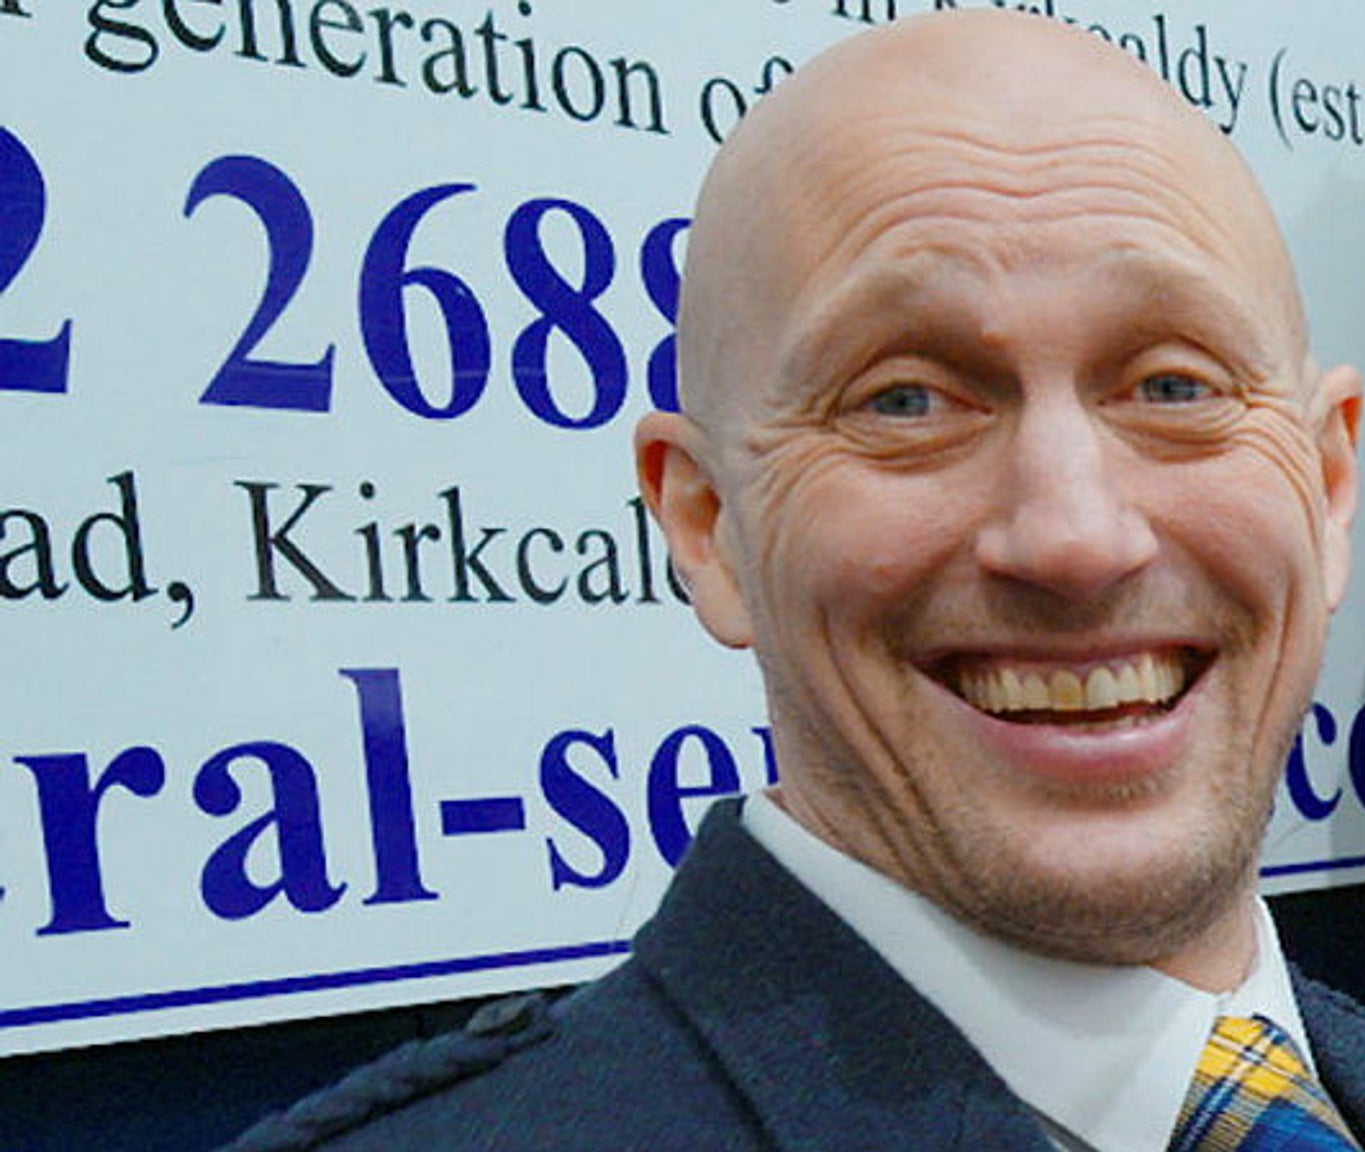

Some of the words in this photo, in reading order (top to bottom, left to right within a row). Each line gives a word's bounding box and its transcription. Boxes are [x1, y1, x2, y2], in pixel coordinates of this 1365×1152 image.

[83, 0, 670, 135] generation
[1269, 47, 1364, 149] (est
[234, 480, 702, 602] Kirkcal
[12, 667, 782, 936] ral-se
